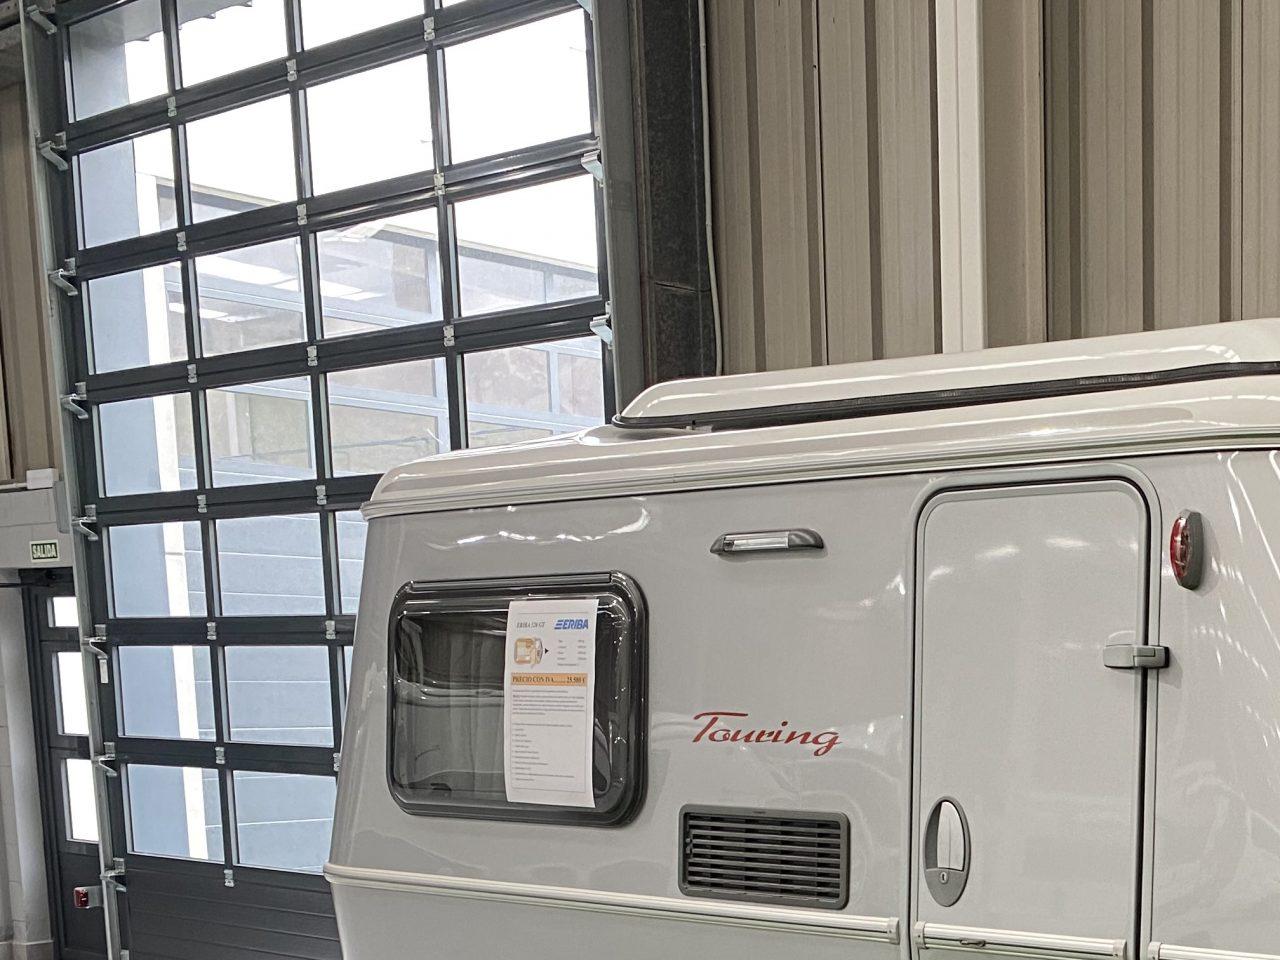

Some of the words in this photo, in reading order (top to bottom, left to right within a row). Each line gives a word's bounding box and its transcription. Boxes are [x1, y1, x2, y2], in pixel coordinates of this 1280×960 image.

[32, 544, 57, 558] SALIDA
[560, 619, 589, 630] ERIBA
[692, 712, 842, 757] Touring
